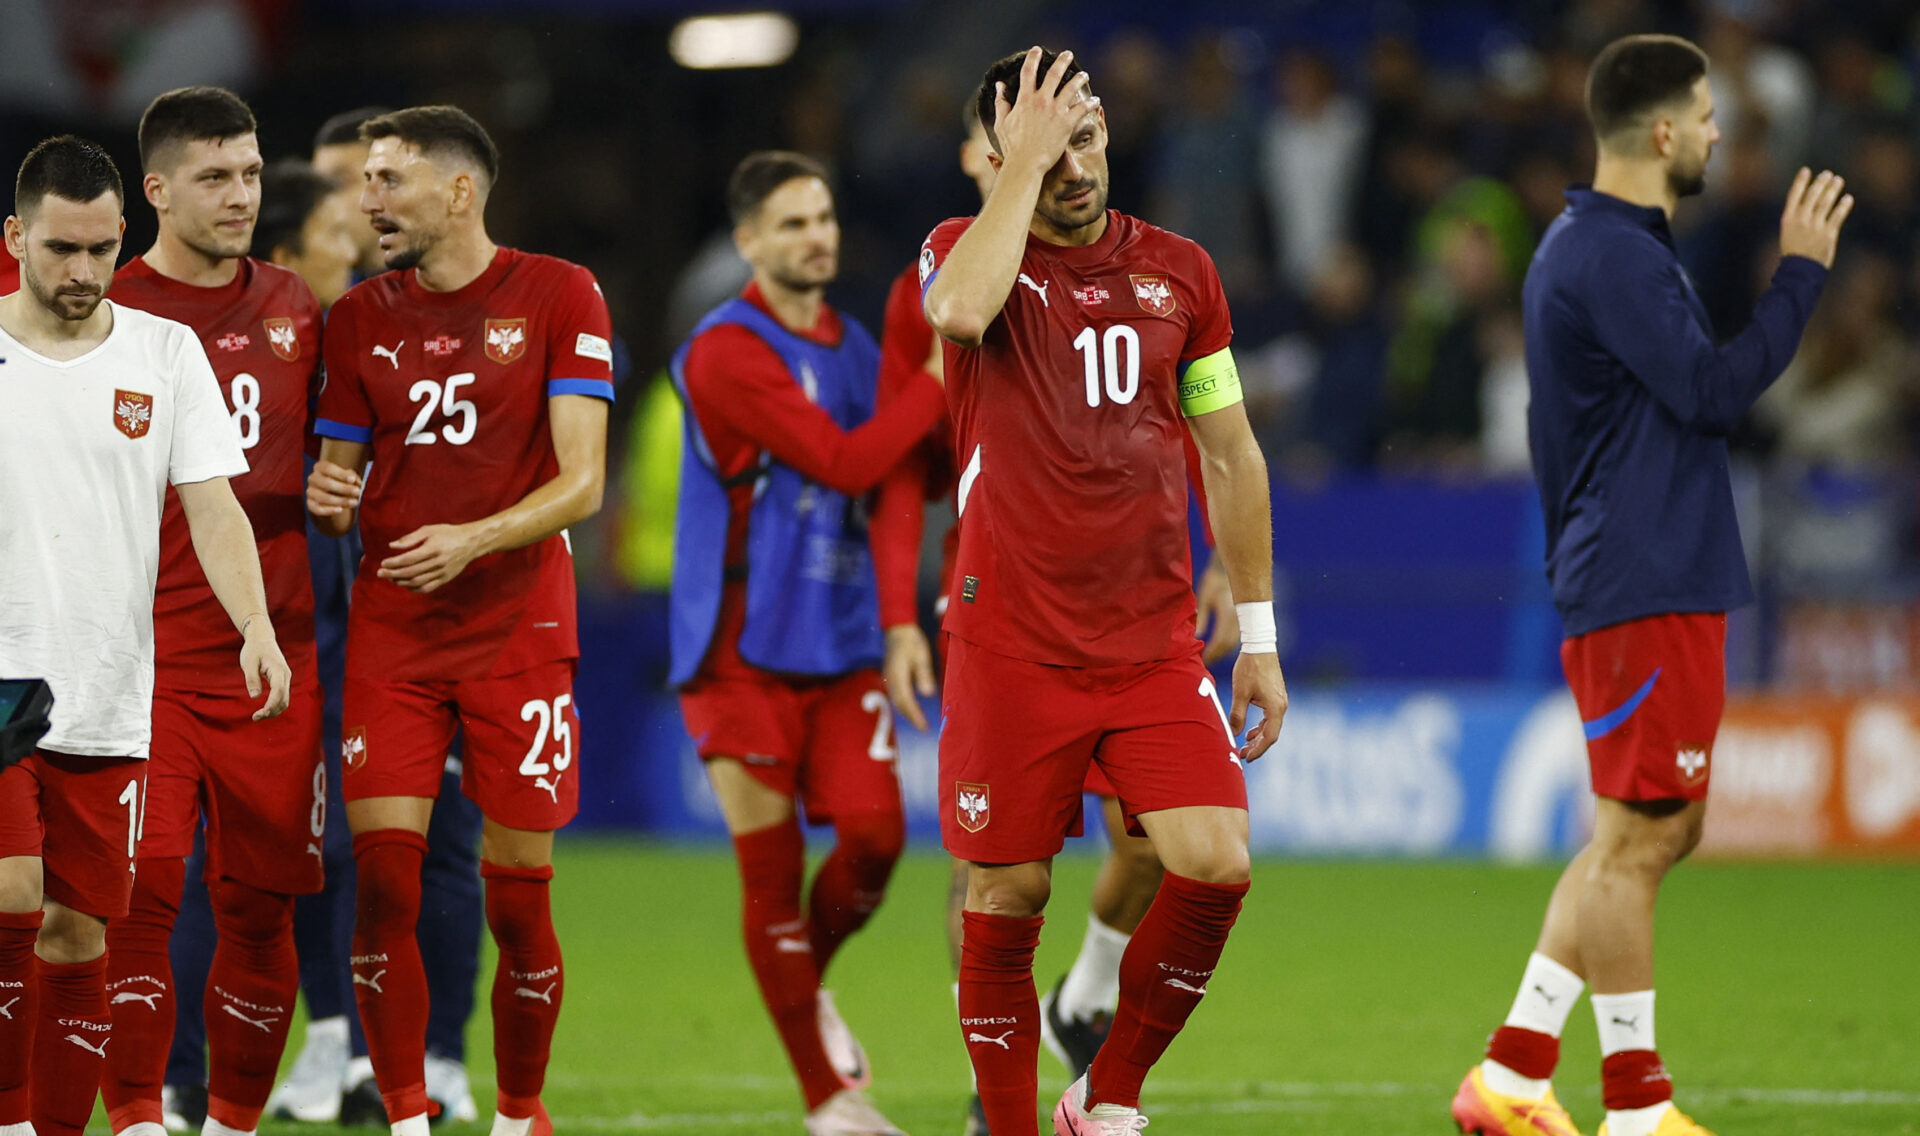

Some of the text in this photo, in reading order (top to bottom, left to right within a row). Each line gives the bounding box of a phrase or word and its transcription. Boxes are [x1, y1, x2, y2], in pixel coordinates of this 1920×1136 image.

[1073, 324, 1140, 408] 10
[1179, 378, 1217, 397] ESPECT
[230, 373, 261, 449] 8
[404, 372, 478, 446] 25
[518, 693, 572, 776] 25
[118, 774, 148, 858] 1
[311, 761, 326, 838] 8
